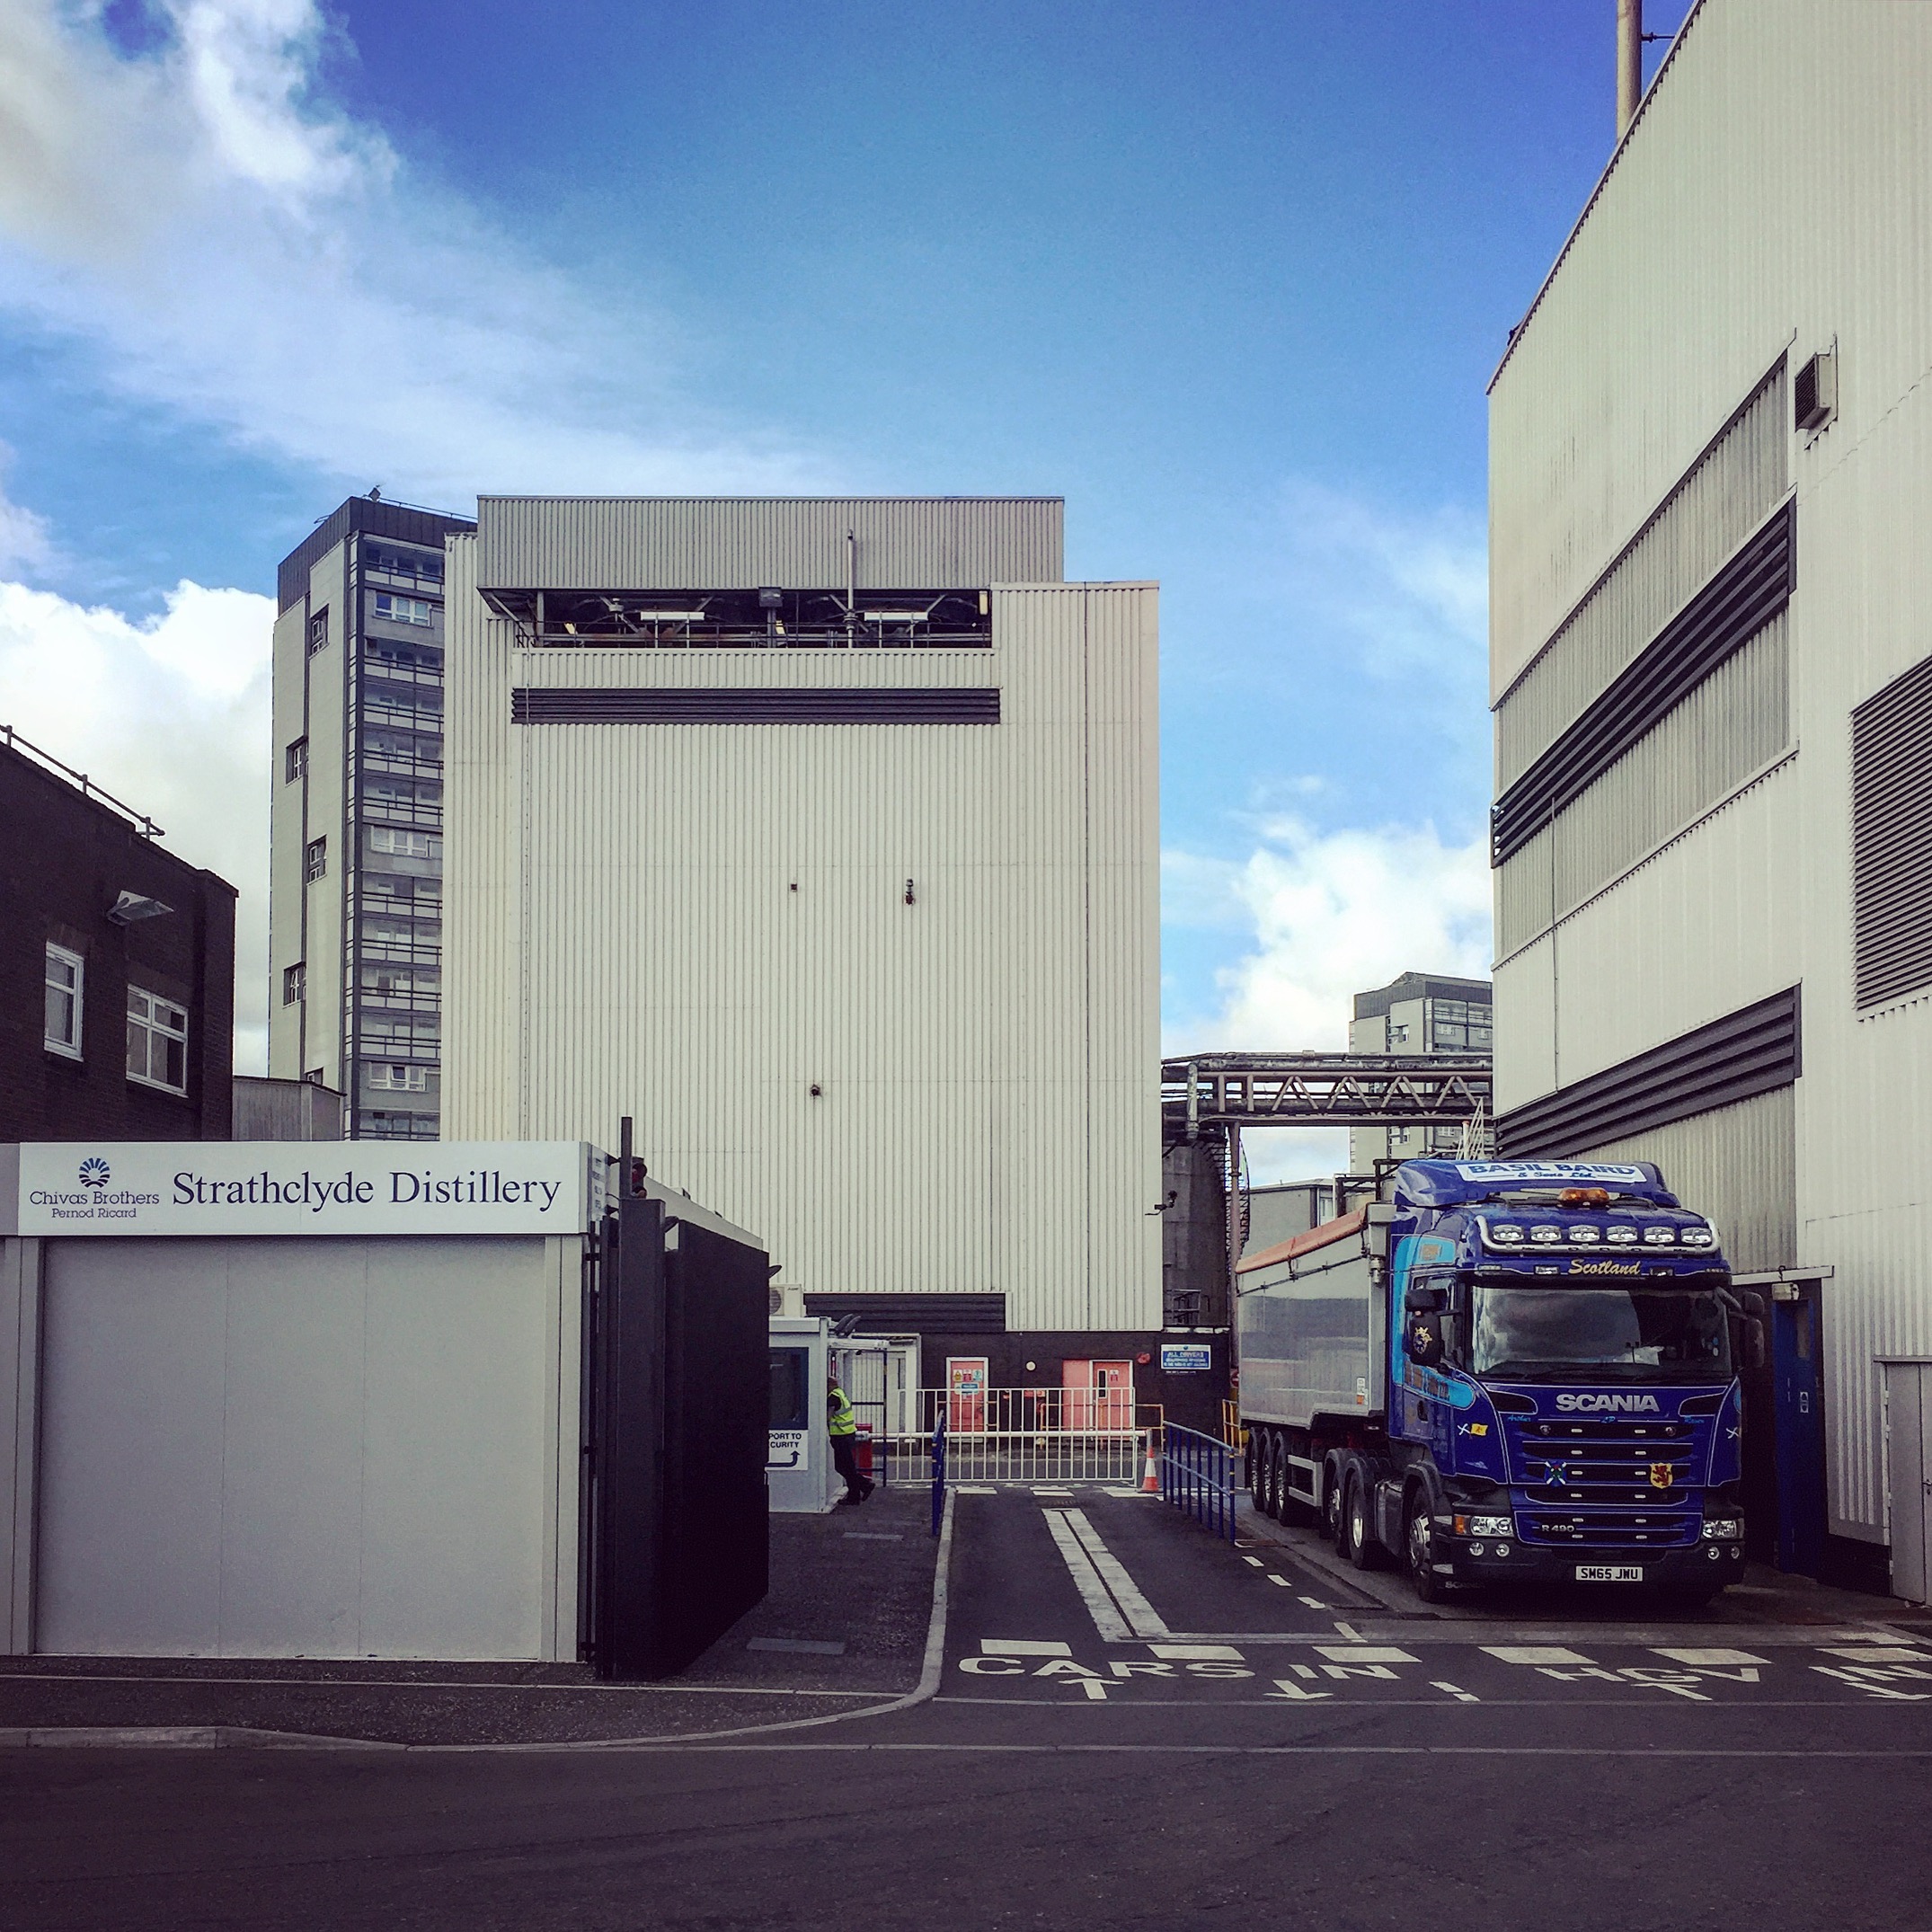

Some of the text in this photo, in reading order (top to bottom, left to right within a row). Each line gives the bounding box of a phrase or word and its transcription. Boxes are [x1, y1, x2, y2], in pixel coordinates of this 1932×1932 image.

[1467, 1164, 1635, 1174] BASIL BAIRD
[30, 1191, 160, 1205] Chivas Brothers
[173, 1170, 374, 1212] Strathclyde
[389, 1170, 562, 1212] Distillery
[51, 1208, 137, 1219] Pernod Ricard
[1568, 1259, 1642, 1275] Scotland
[1555, 1394, 1660, 1413] SCANIA
[1552, 1525, 1575, 1533] 490
[1581, 1567, 1612, 1580] SM65
[958, 1657, 1402, 1679] CARS IN
[1534, 1666, 1761, 1682] HGV
